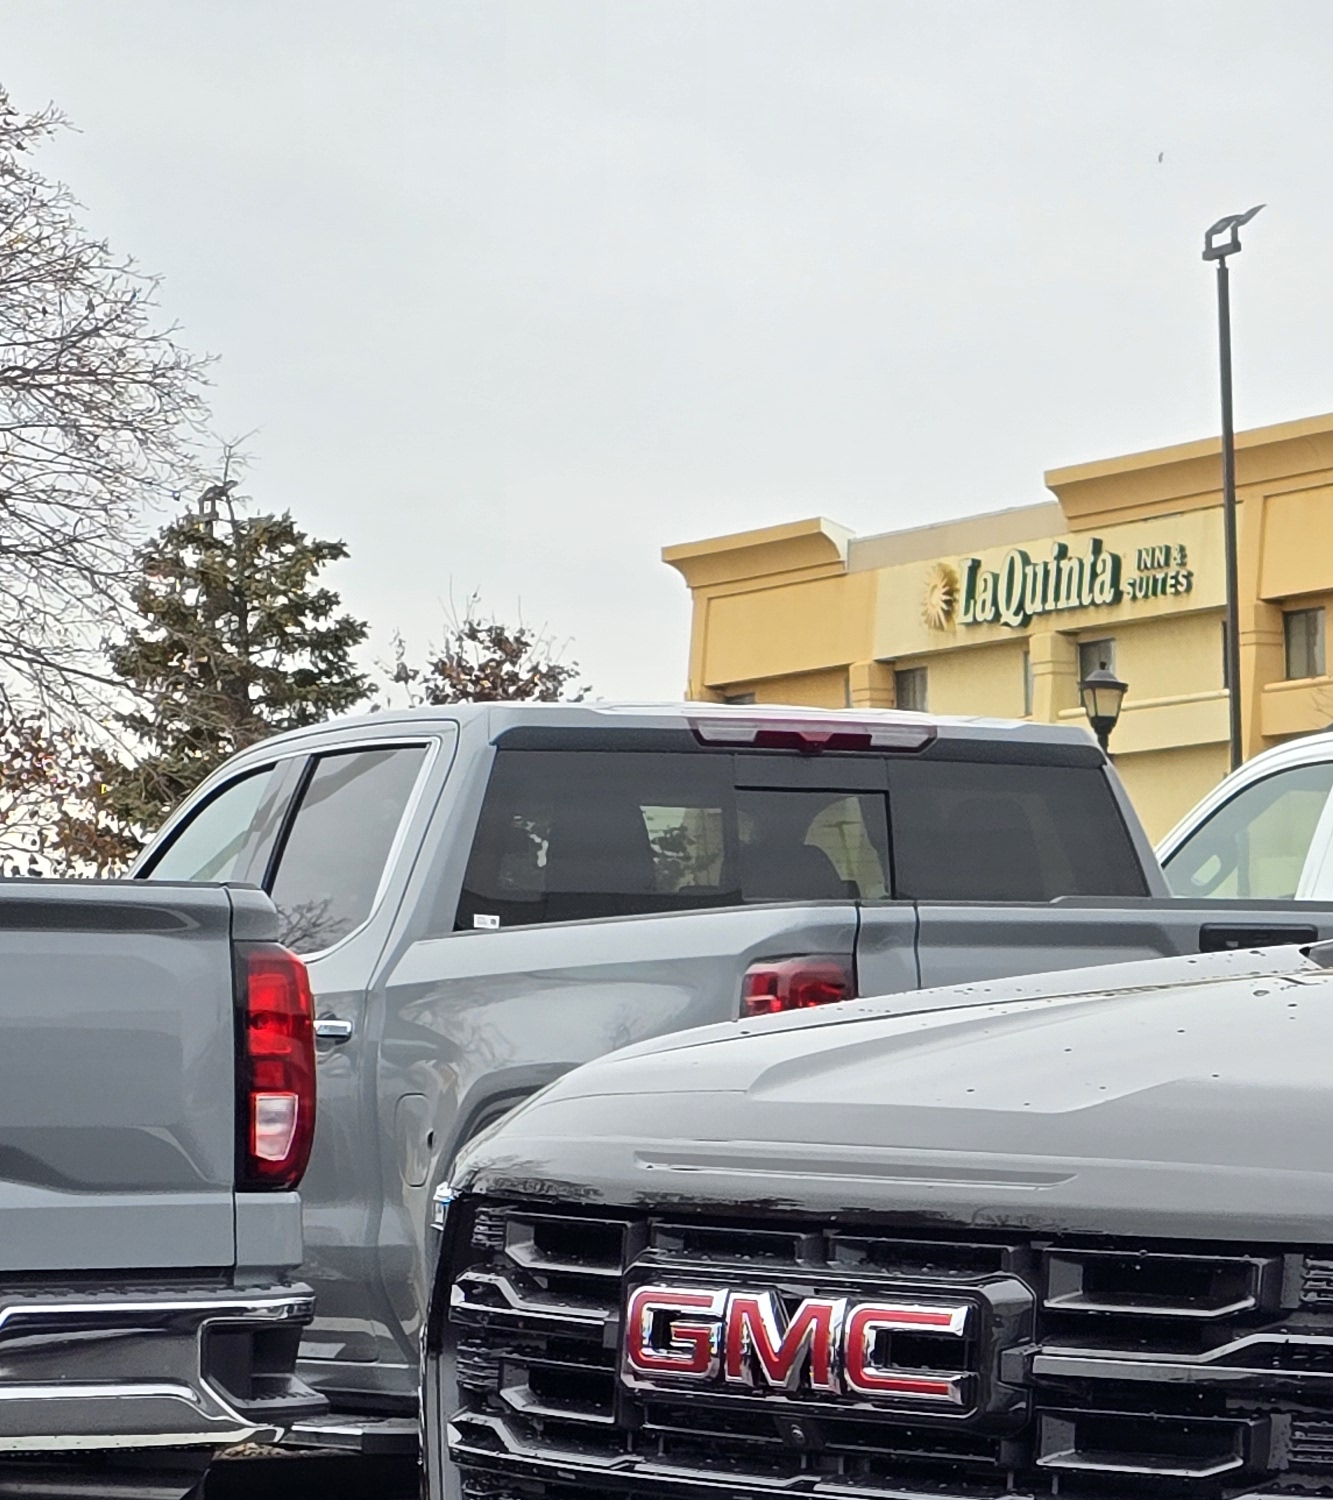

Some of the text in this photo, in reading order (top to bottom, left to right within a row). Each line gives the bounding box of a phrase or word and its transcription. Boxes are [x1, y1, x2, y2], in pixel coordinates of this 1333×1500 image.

[1172, 543, 1188, 567] &
[1125, 569, 1193, 602] SUITES
[624, 1285, 978, 1405] GMC
